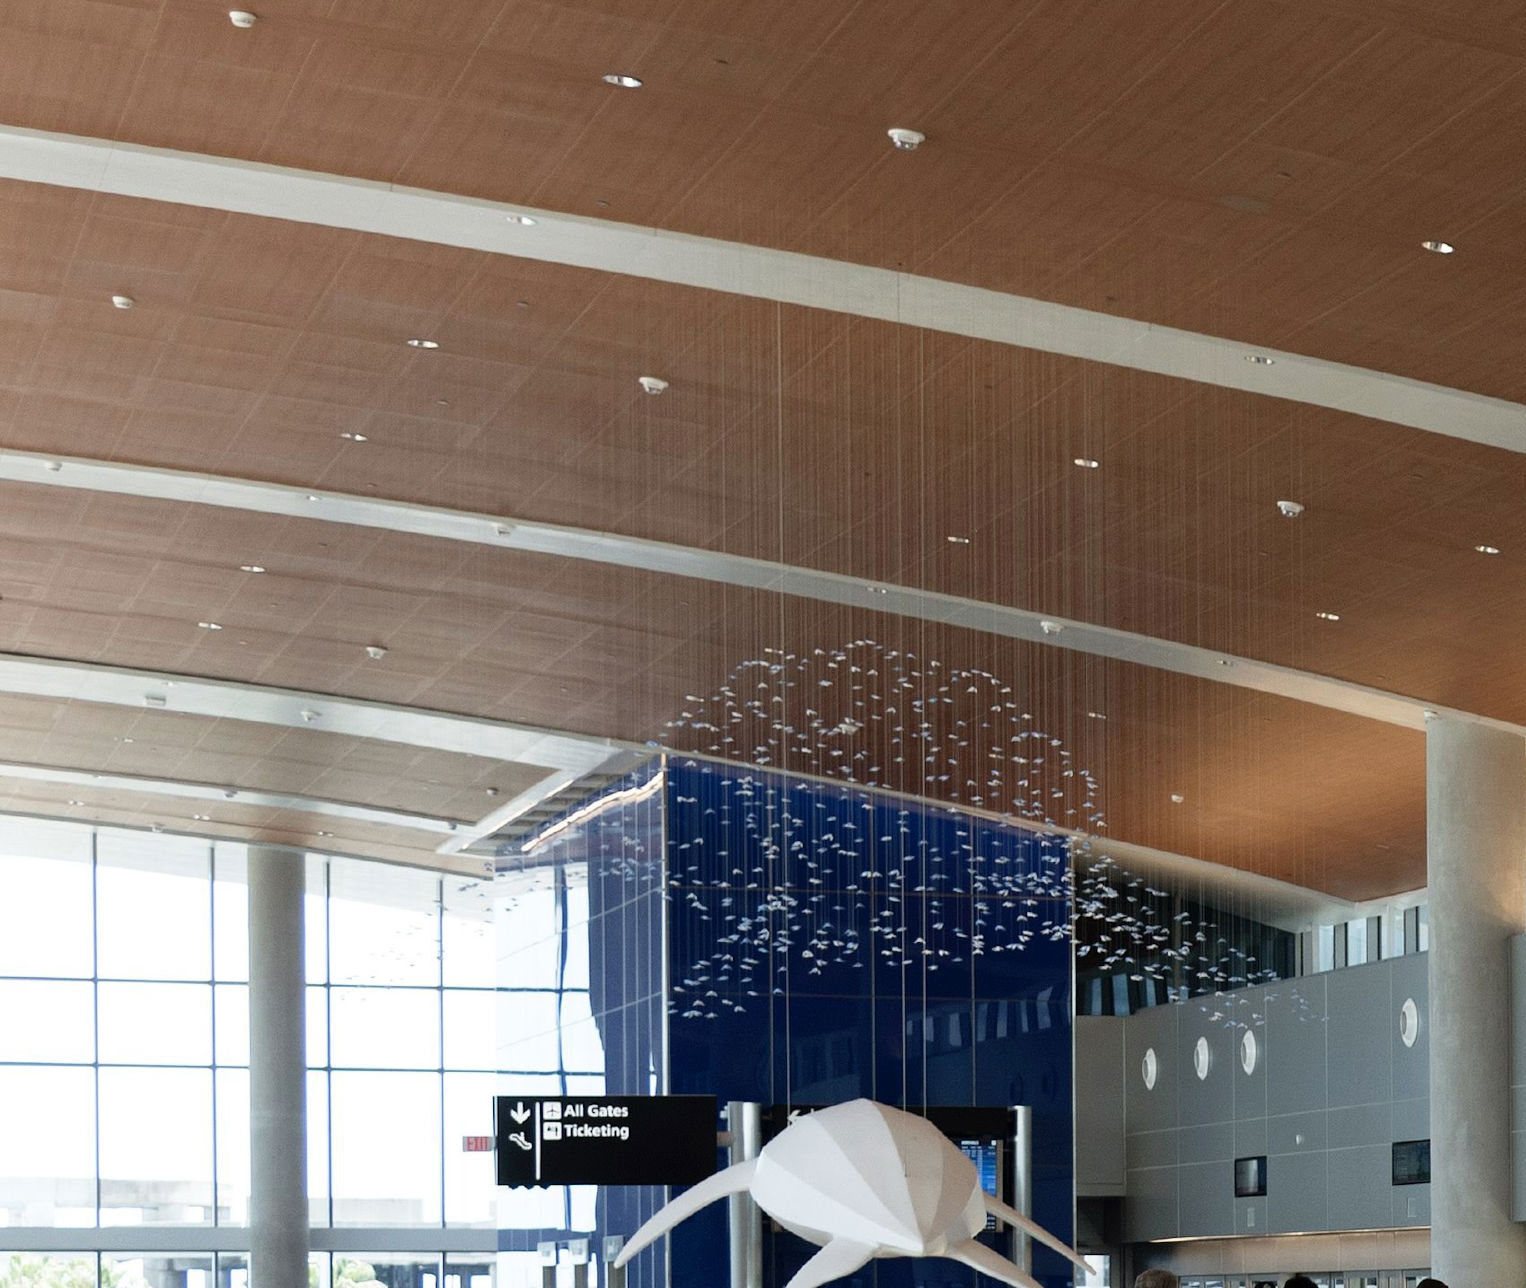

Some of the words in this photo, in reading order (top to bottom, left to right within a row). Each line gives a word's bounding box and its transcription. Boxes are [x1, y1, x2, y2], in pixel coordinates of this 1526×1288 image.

[563, 1103, 584, 1117] All
[587, 1104, 629, 1118] Gates
[564, 1123, 630, 1141] Ticketing
[466, 1136, 489, 1152] EXIT
